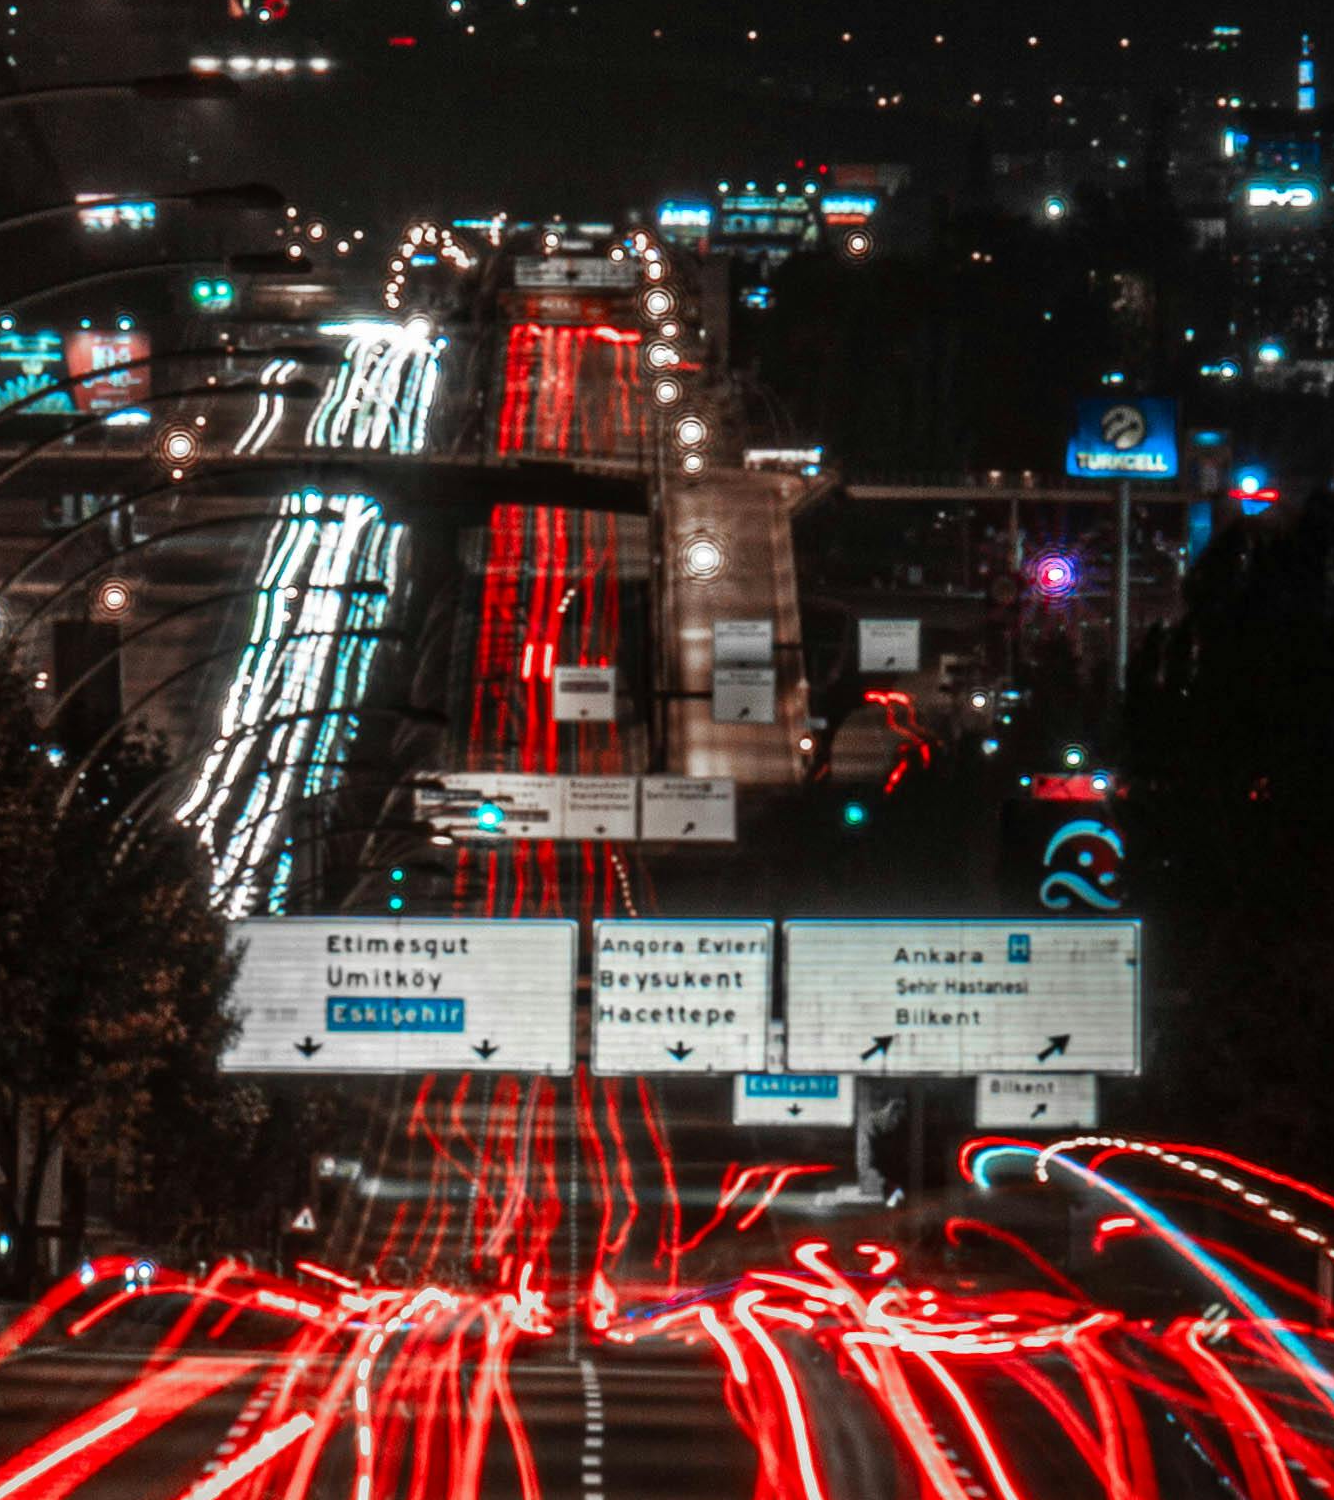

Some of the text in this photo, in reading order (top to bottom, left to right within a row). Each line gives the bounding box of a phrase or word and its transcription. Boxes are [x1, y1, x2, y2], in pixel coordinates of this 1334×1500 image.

[326, 934, 469, 960] Etimesgut
[601, 937, 766, 957] Angora Evleri
[893, 946, 985, 964] Ankara
[599, 969, 744, 993] Beysukent
[895, 977, 1029, 996] Şehir Hastanesi
[332, 1002, 461, 1027] Eskişehir
[599, 1004, 737, 1027] Hacettepe
[895, 1007, 981, 1026] Bilkent
[989, 1078, 1055, 1094] Bilkent
